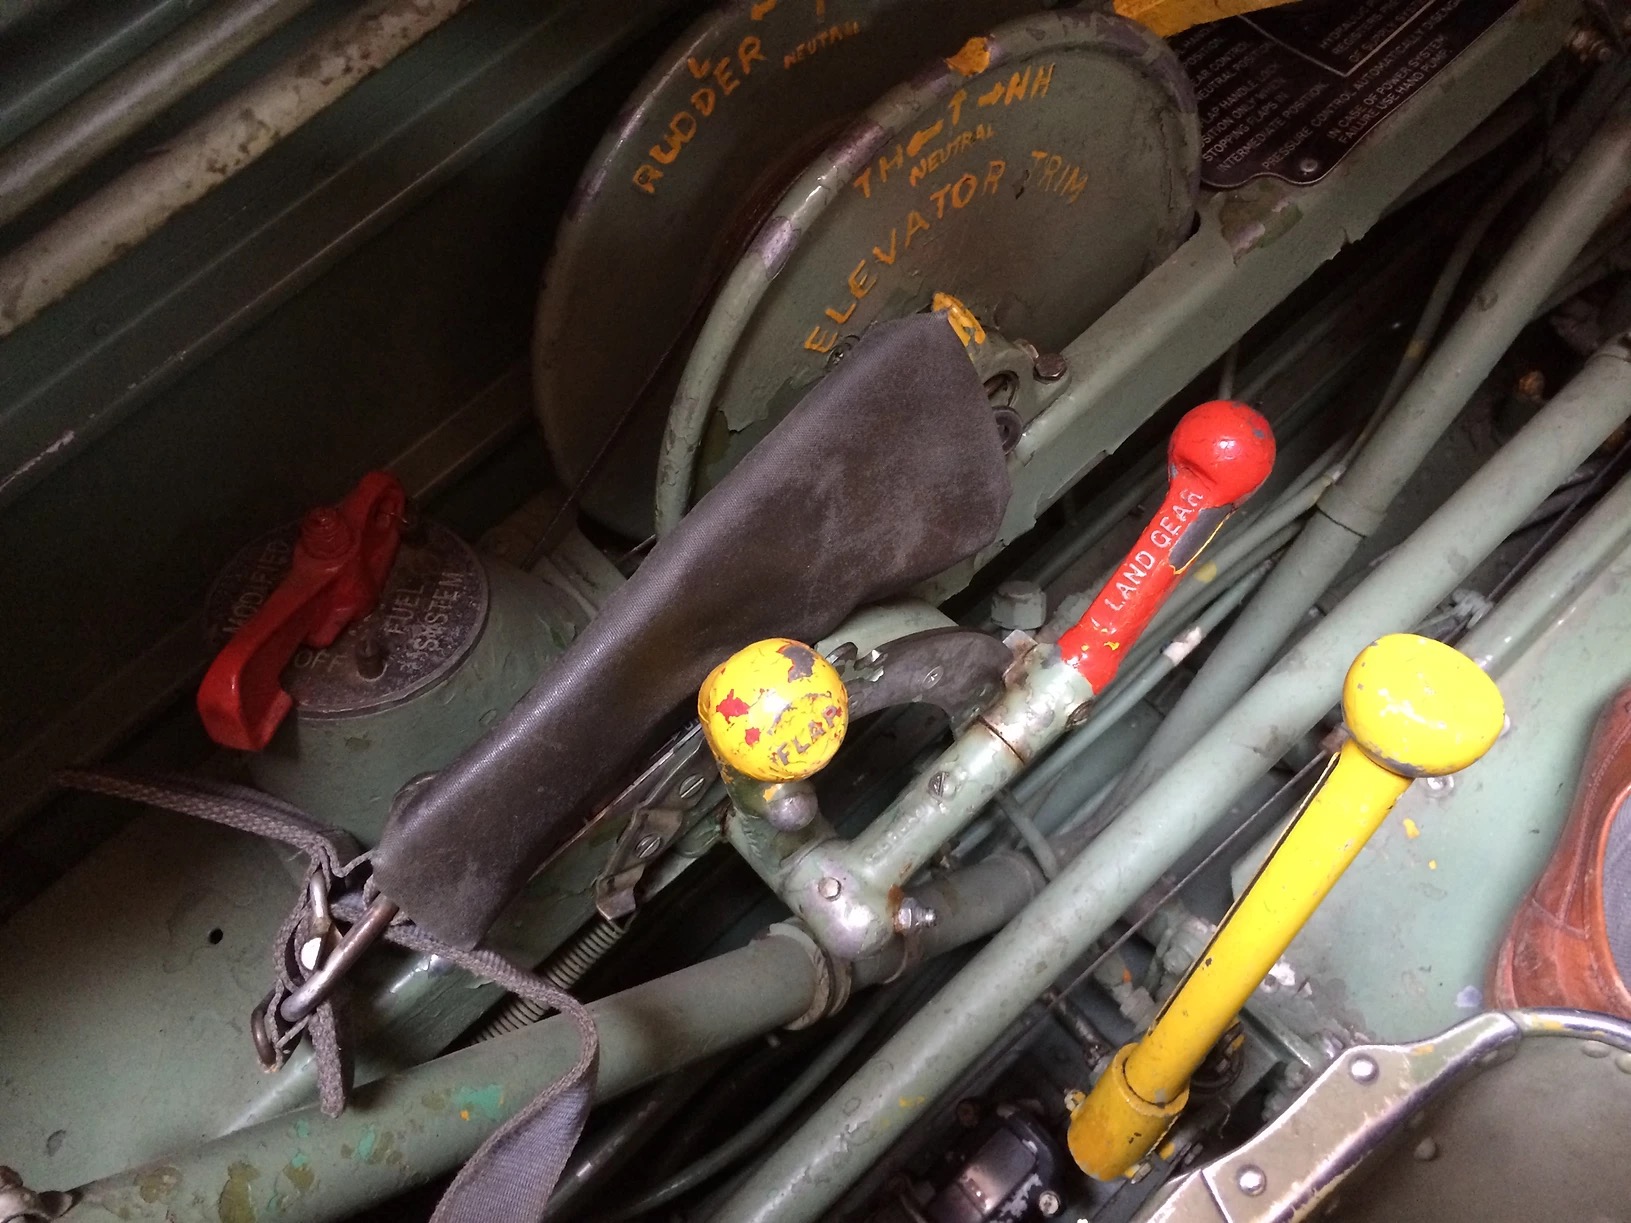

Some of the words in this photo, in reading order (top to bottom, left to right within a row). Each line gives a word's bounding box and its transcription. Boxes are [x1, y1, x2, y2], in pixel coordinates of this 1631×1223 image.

[1194, 69, 1212, 89] EAR
[1261, 125, 1314, 170] PRESSURE
[1353, 28, 1425, 91] AUTOMATICALLY
[1326, 127, 1341, 140] IN
[1338, 103, 1368, 128] CASE
[1363, 92, 1378, 106] OF
[1376, 66, 1411, 95] POWER
[1407, 33, 1448, 69] SYSTEM
[1338, 107, 1381, 144] FAILURE
[1376, 92, 1400, 111] USE
[1395, 71, 1425, 95] HAND
[632, 36, 767, 193] RUDDER
[1200, 106, 1220, 125] LAP
[1201, 123, 1250, 162] STOPPING
[1246, 101, 1279, 126] FLAPS
[1217, 116, 1287, 172] INTERMEDIATE
[909, 124, 995, 186] NEUTRAL
[803, 160, 1007, 354] ELEVATOR
[1031, 150, 1089, 204] TRIM
[1104, 550, 1155, 611] LAND
[1150, 488, 1204, 548] GEAR
[384, 585, 427, 635] FUEL
[412, 571, 466, 652] SYSTEM
[294, 650, 348, 672] OFF
[775, 705, 838, 767] FLAP
